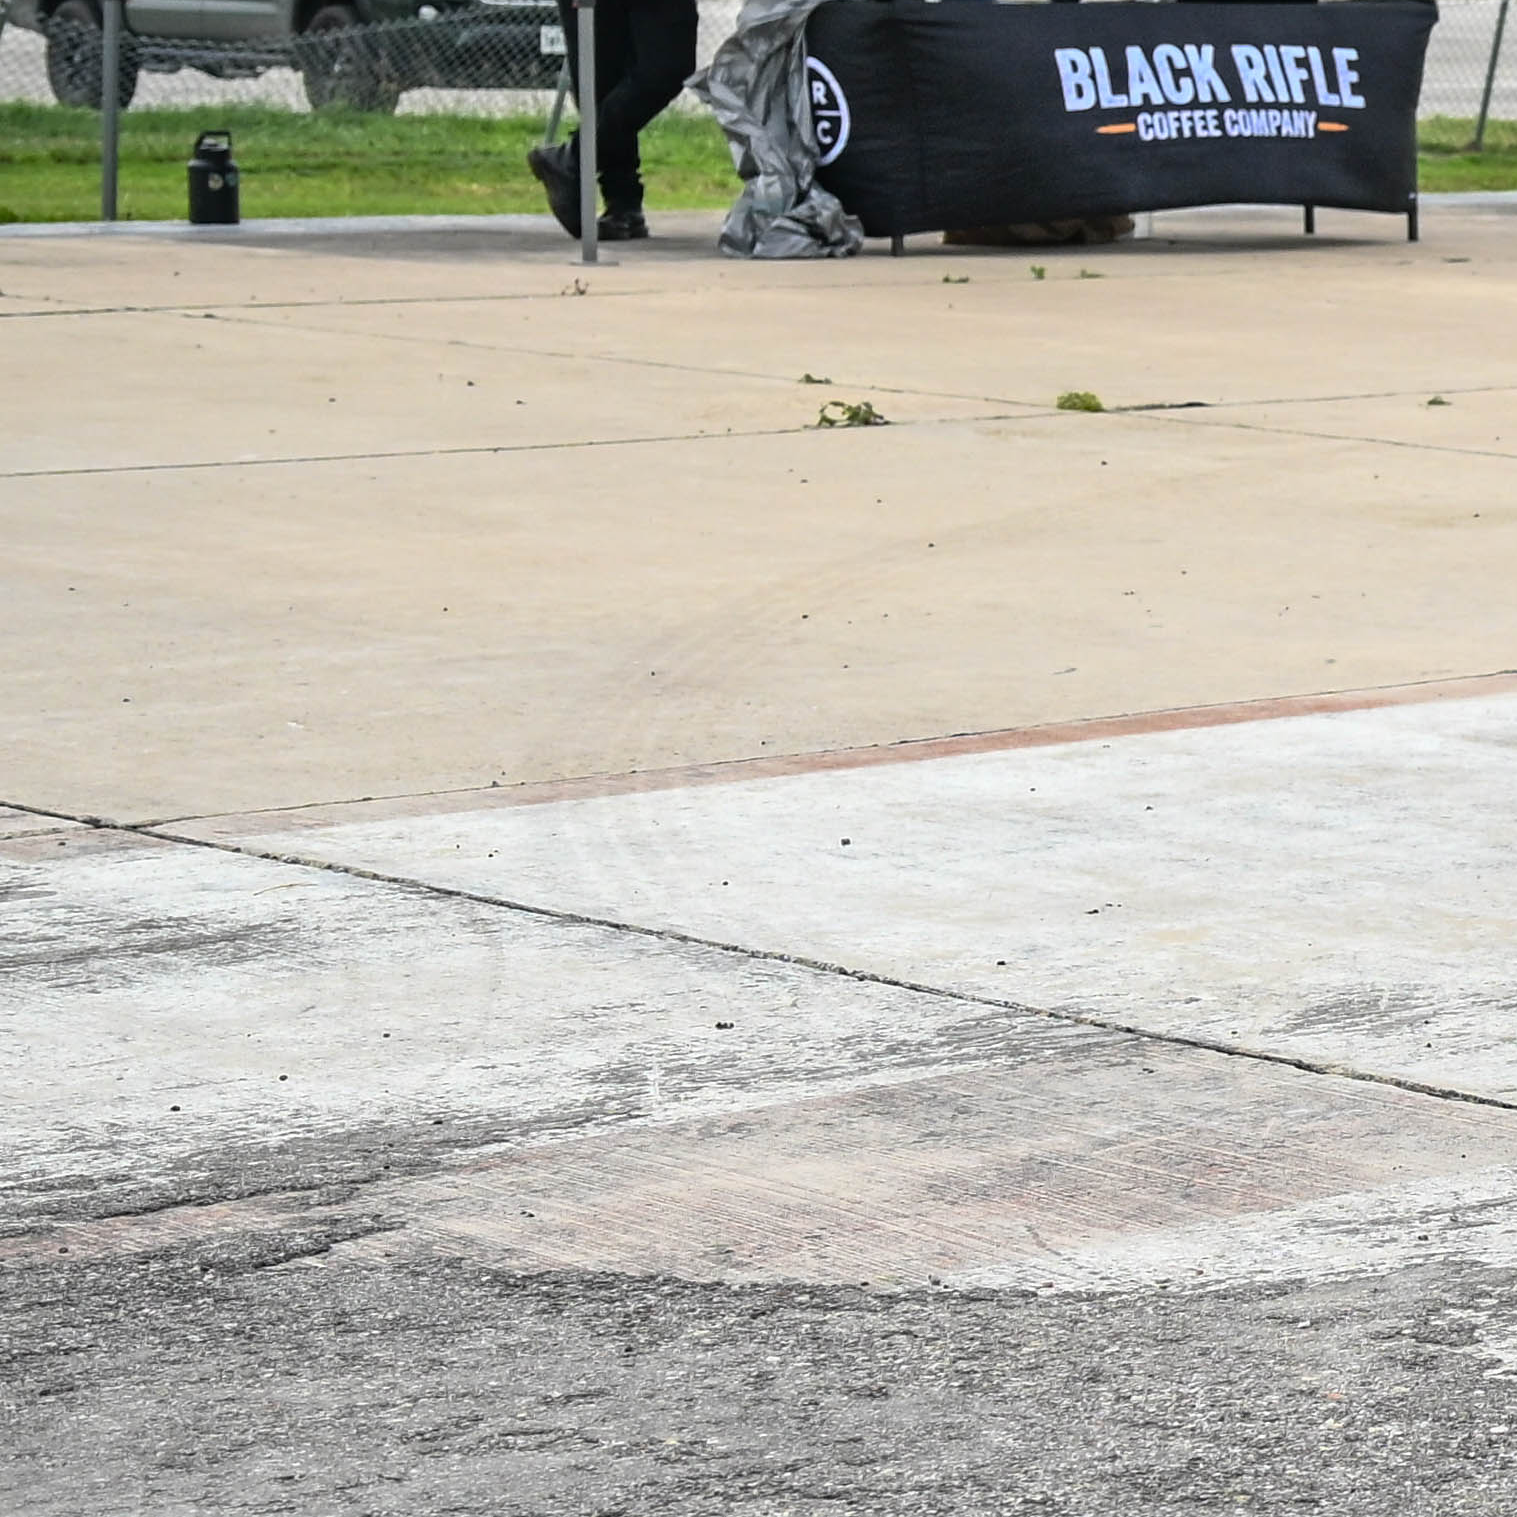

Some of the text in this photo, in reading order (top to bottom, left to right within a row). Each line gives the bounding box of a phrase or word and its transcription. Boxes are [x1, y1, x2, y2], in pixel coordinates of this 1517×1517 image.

[1054, 43, 1367, 112] BLACK RIFLE
[1137, 108, 1318, 141] COFFEE COMPANY
